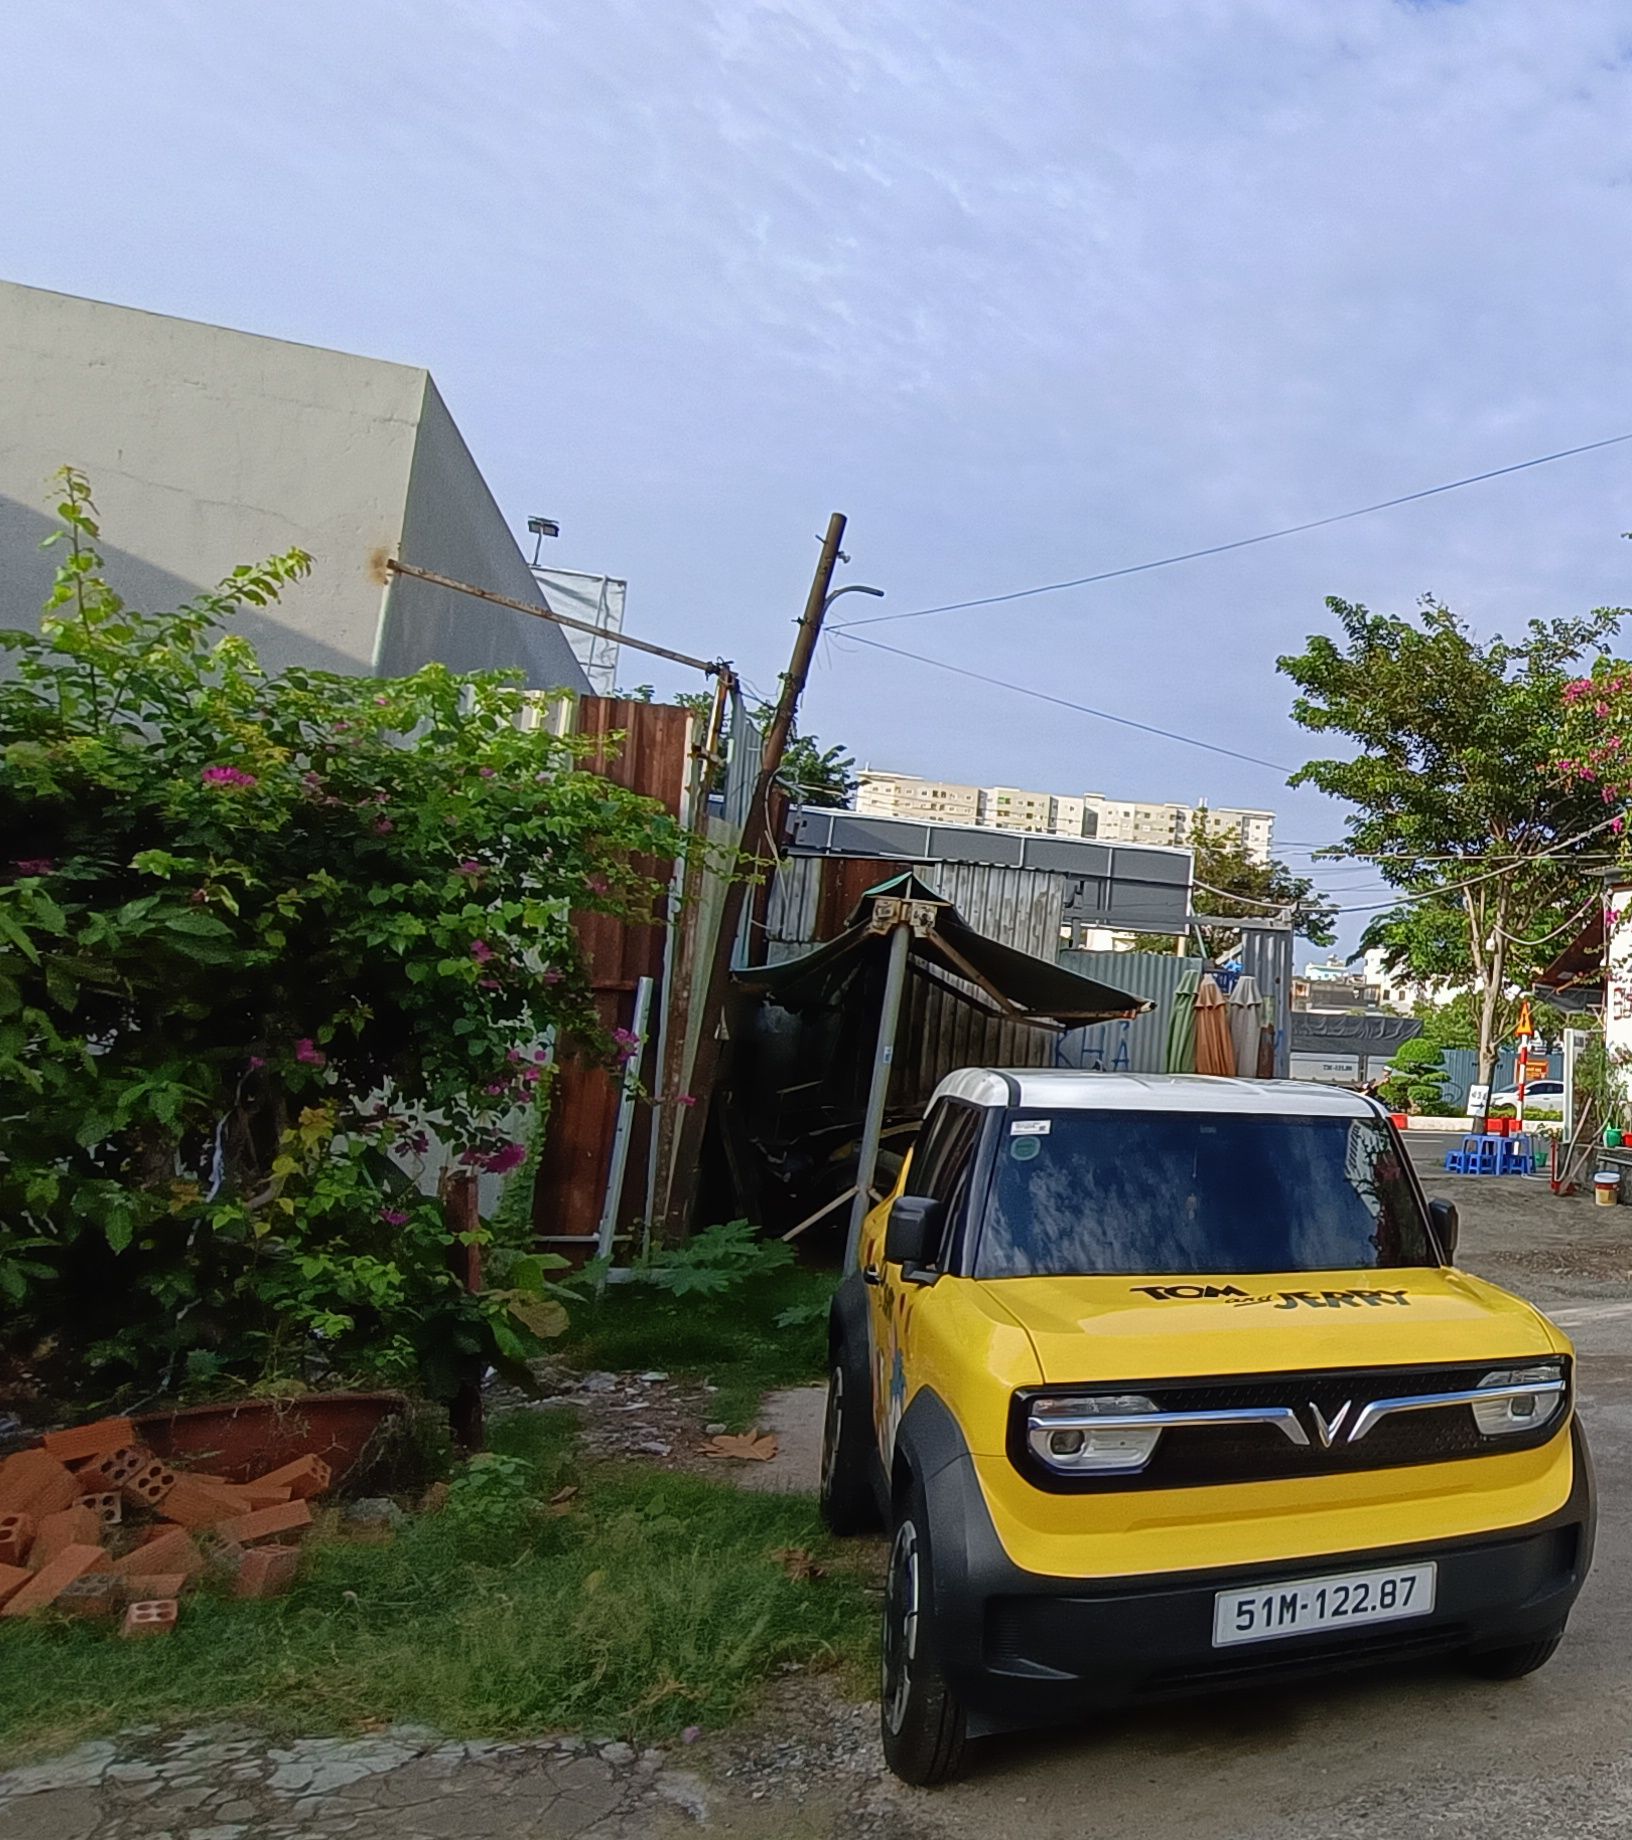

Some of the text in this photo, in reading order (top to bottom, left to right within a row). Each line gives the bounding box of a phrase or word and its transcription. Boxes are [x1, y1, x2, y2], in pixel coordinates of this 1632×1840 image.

[1129, 1285, 1412, 1310] TOM and JERRY
[1235, 1575, 1417, 1631] 51M-122.87
